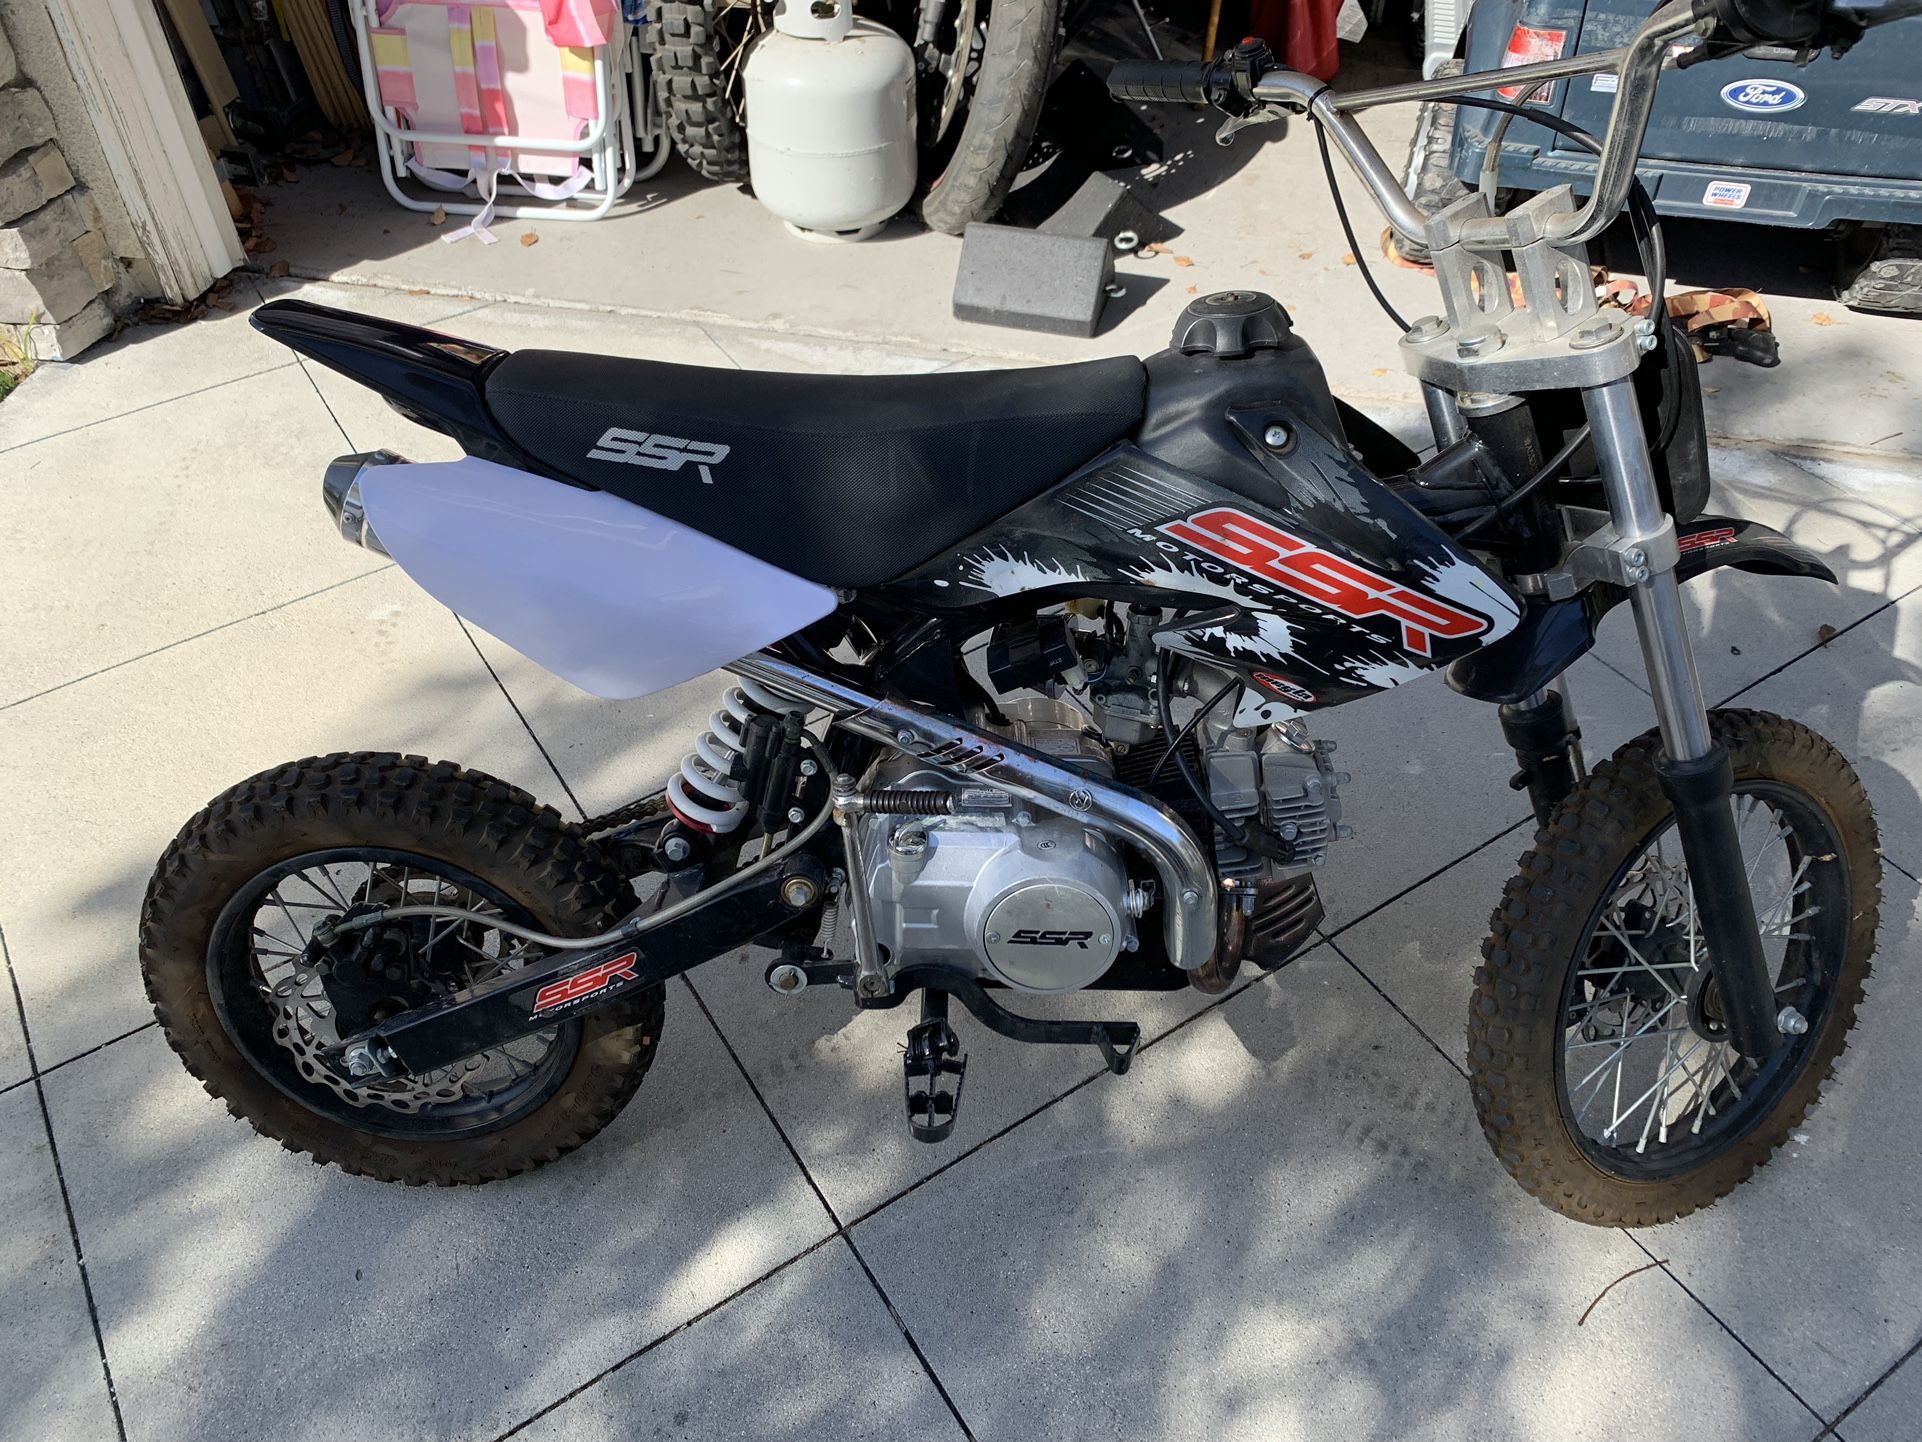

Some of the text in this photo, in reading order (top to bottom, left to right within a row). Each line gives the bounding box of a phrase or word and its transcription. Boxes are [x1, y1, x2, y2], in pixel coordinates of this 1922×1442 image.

[1738, 84, 1786, 105] Ford
[586, 427, 731, 484] SSR
[1127, 528, 1392, 644] MOTORSPORTS
[1155, 505, 1488, 658] SSR
[1007, 929, 1093, 949] SSR
[533, 951, 639, 1013] SSR
